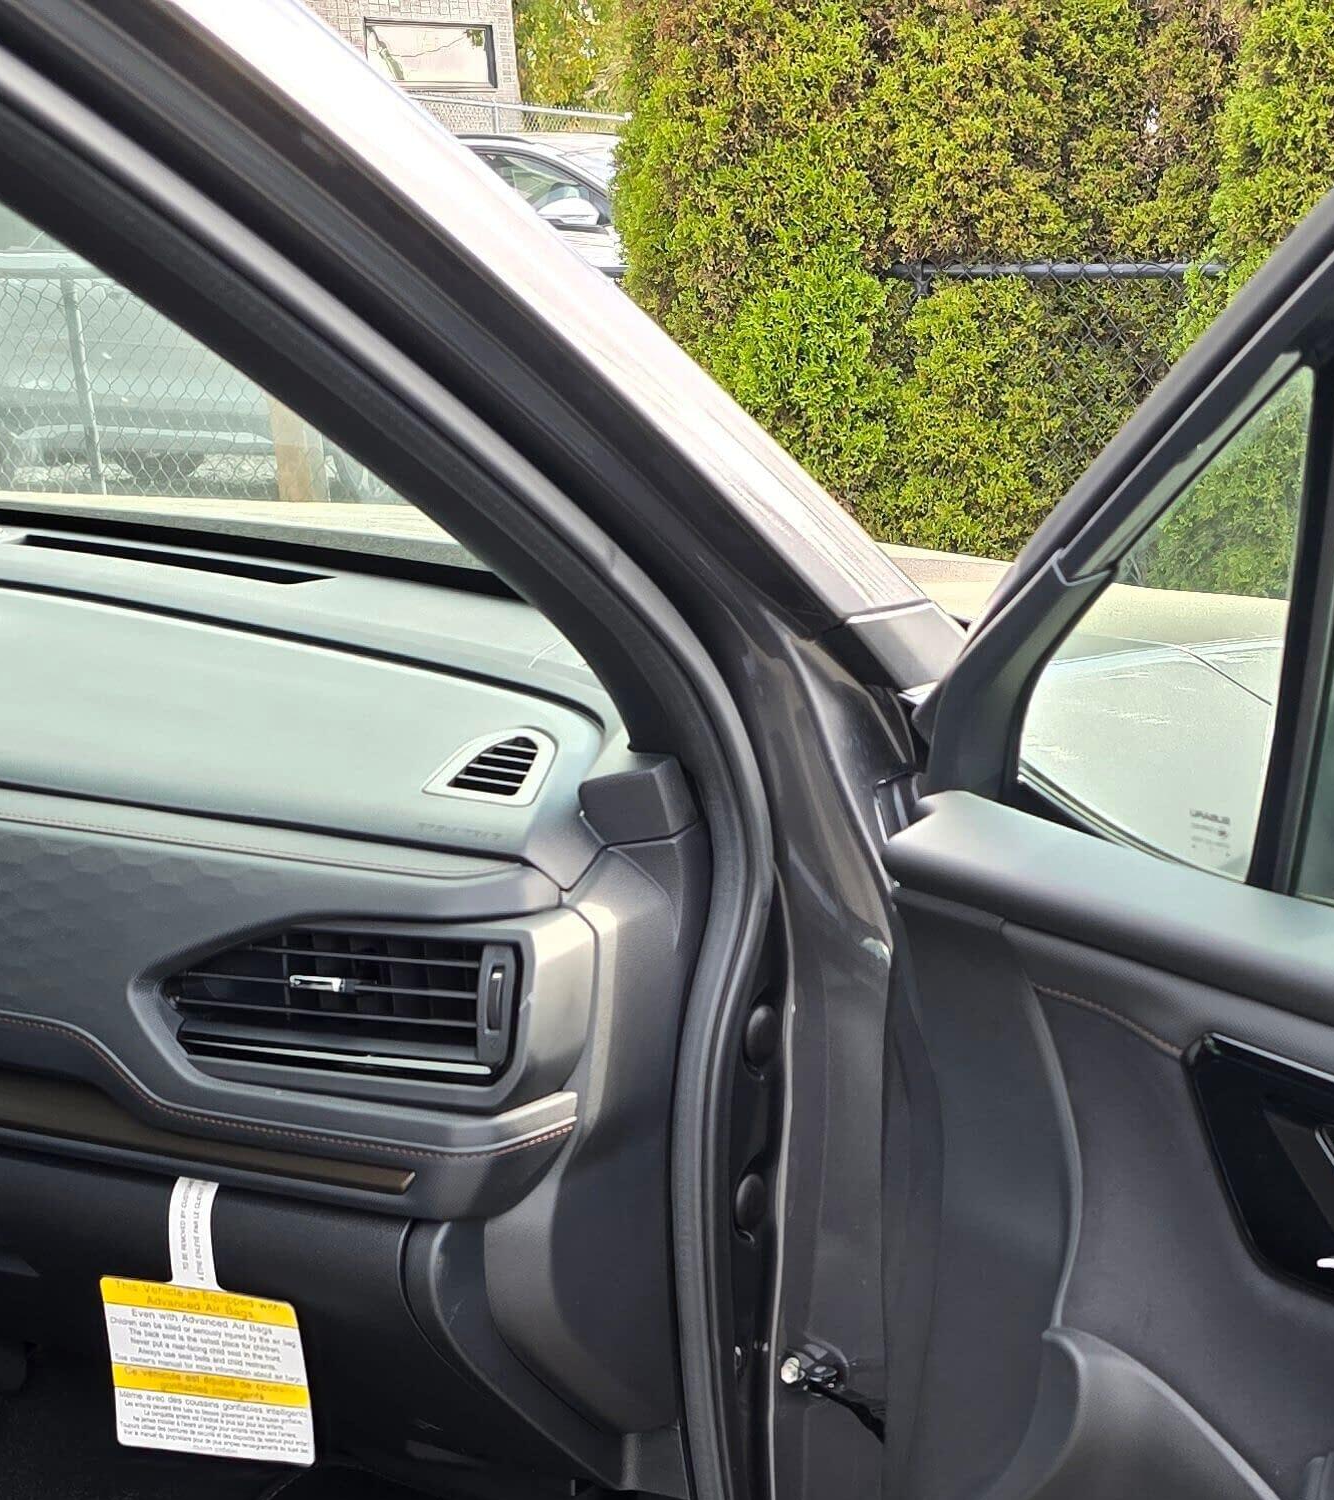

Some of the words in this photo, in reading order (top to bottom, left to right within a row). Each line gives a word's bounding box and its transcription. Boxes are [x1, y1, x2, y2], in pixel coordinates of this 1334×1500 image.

[142, 1283, 183, 1296] Vehicle
[187, 1289, 196, 1298] is
[202, 1291, 253, 1308] Equipped
[146, 1295, 200, 1310] Advanced
[205, 1303, 219, 1312] Air
[225, 1305, 253, 1320] Bags
[131, 1308, 155, 1318] Even
[159, 1311, 177, 1321] with
[181, 1314, 228, 1328] Advanced
[231, 1321, 244, 1330] Air
[249, 1324, 272, 1335] Bags
[138, 1320, 151, 1328] can
[164, 1323, 181, 1332] killed
[193, 1327, 221, 1338] seriously
[224, 1331, 246, 1341] injured
[248, 1334, 256, 1342] by
[259, 1335, 269, 1343] the
[129, 1327, 141, 1335] The
[144, 1329, 159, 1338] back
[162, 1331, 176, 1340] seat
[178, 1333, 183, 1341] is
[186, 1334, 197, 1342] the
[130, 1337, 149, 1346] Never
[208, 1347, 224, 1355] child
[227, 1349, 241, 1357] seat
[243, 1351, 250, 1359] in
[252, 1352, 262, 1360] the
[137, 1347, 160, 1357] Always
[162, 1350, 175, 1358] use
[212, 1356, 224, 1364] and
[227, 1358, 242, 1366] child
[145, 1393, 164, 1402] avec
[167, 1395, 182, 1404] des
[185, 1397, 218, 1408] coussins
[222, 1402, 262, 1415] gonflables
[266, 1406, 307, 1419] intelligents
